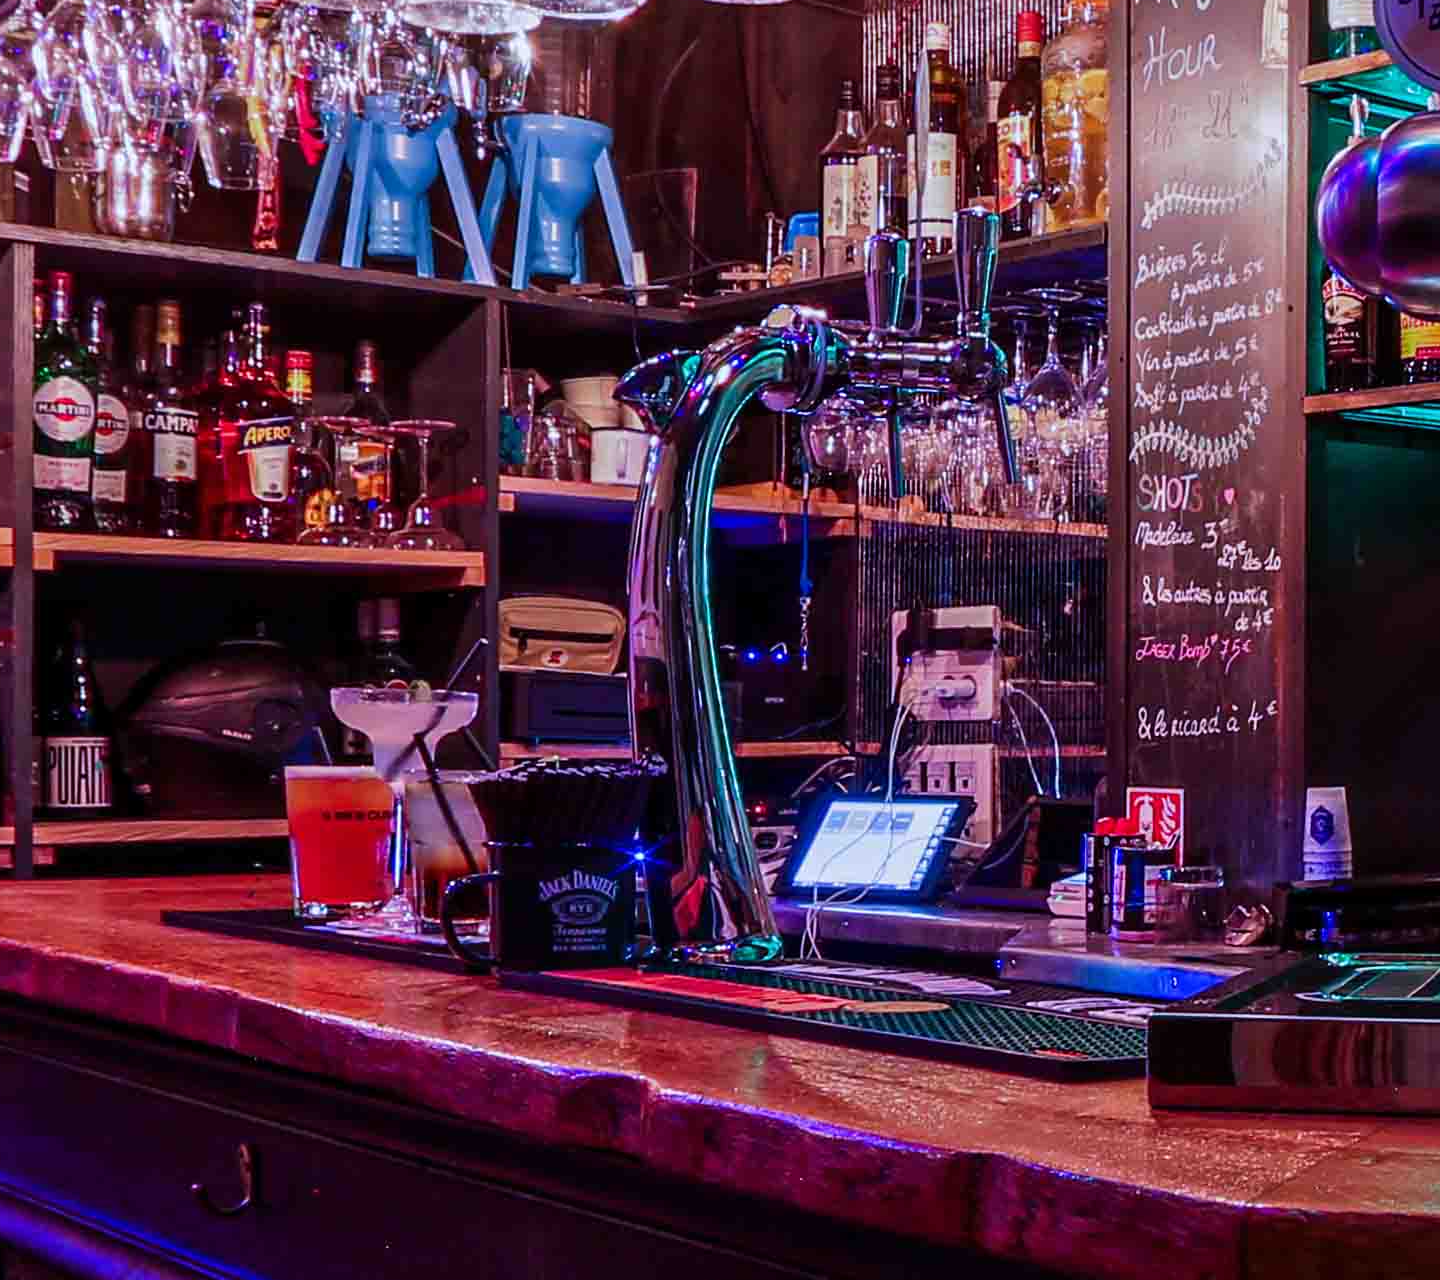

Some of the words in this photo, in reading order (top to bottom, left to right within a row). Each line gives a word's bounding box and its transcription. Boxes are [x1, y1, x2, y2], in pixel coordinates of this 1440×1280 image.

[1143, 25, 1224, 93] HOUR
[1136, 349, 1161, 381] Vin
[37, 403, 90, 417] MARTINI
[1136, 472, 1204, 512] SHOTS
[1138, 706, 1153, 741] &
[539, 875, 571, 901] JACK
[573, 869, 618, 901] DANIEL'S
[569, 903, 593, 913] RYE
